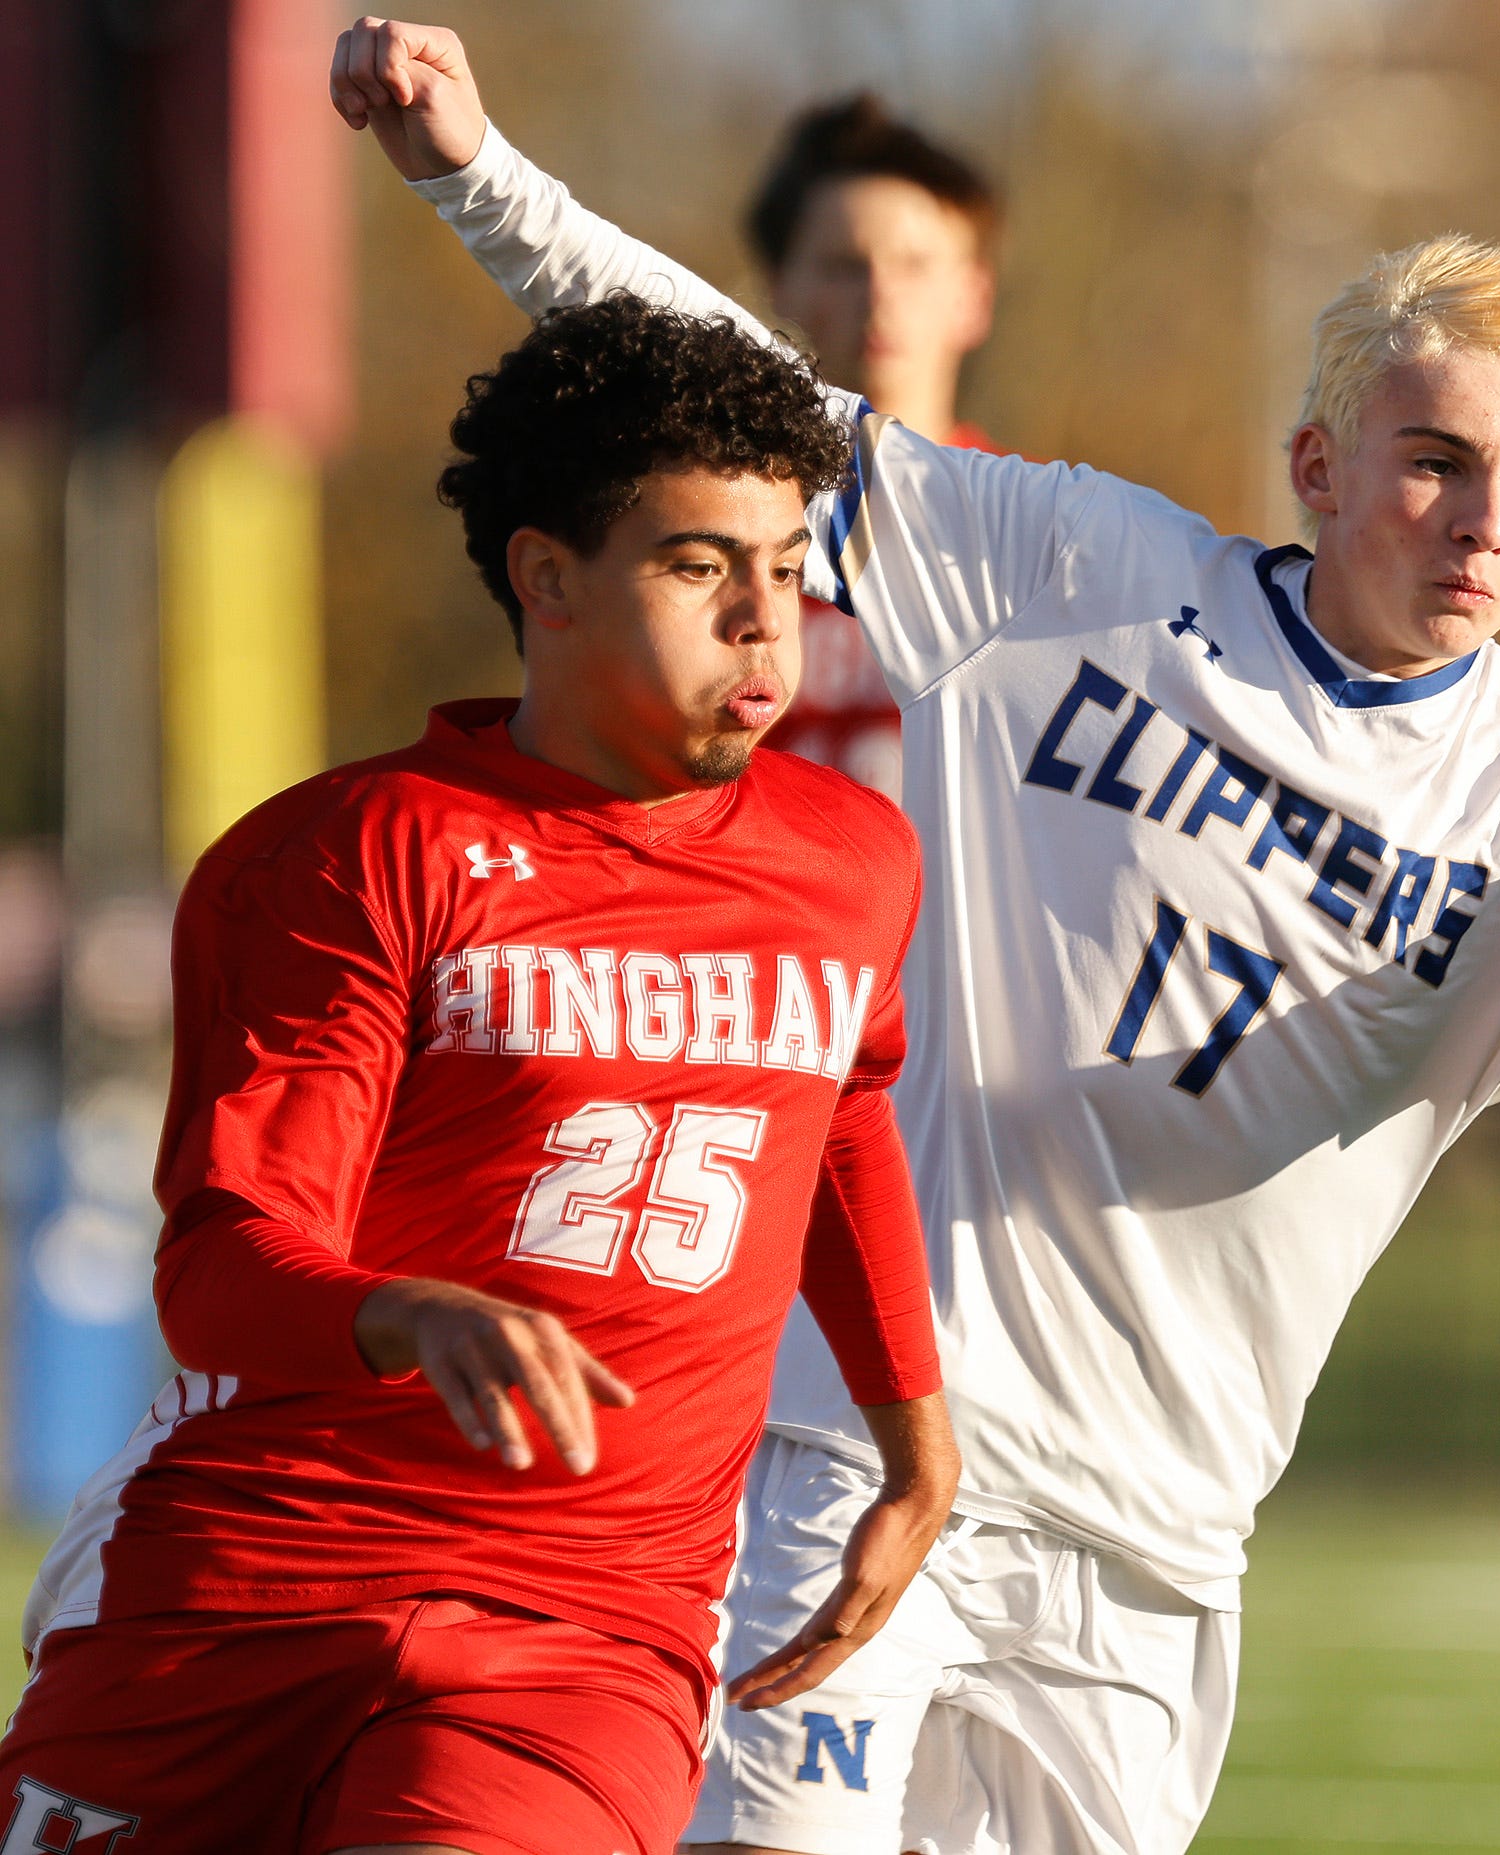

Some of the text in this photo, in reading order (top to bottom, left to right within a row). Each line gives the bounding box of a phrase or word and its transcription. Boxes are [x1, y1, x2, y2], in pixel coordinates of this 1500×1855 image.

[1021, 655, 1490, 990] CLIPPERS
[425, 945, 874, 1088] HINGHAM
[1101, 893, 1288, 1100] 17
[504, 1102, 767, 1293] 25
[795, 1710, 876, 1793] N
